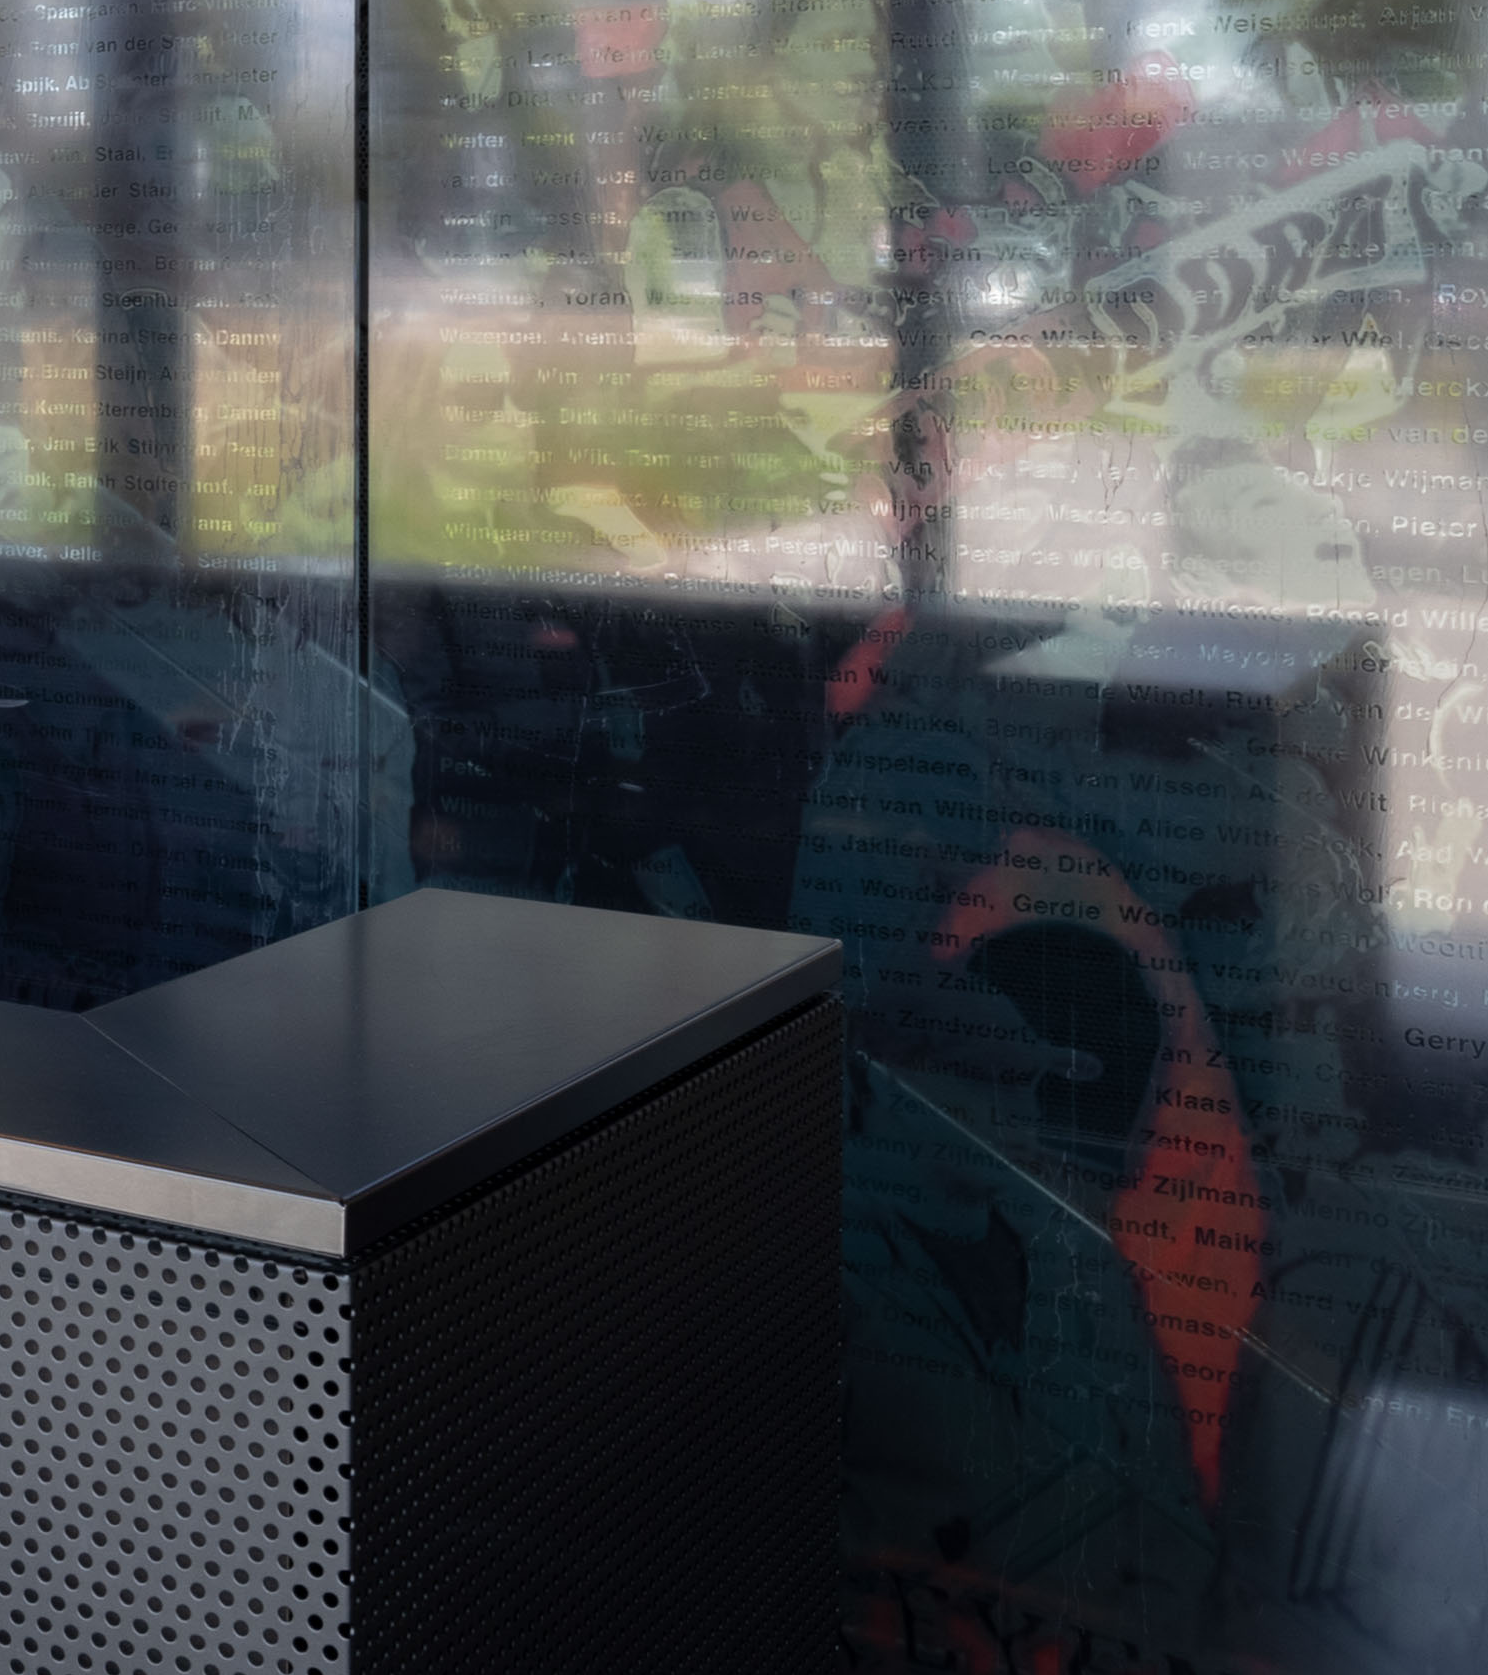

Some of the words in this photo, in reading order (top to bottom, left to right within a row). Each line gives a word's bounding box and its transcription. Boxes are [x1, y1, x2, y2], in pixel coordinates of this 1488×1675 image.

[1391, 516, 1478, 539] Pieter
[1056, 854, 1113, 879] Dirk
[1012, 893, 1102, 921] Gerdie
[1404, 1027, 1486, 1059] Gerry
[1153, 1087, 1231, 1115] Klaas
